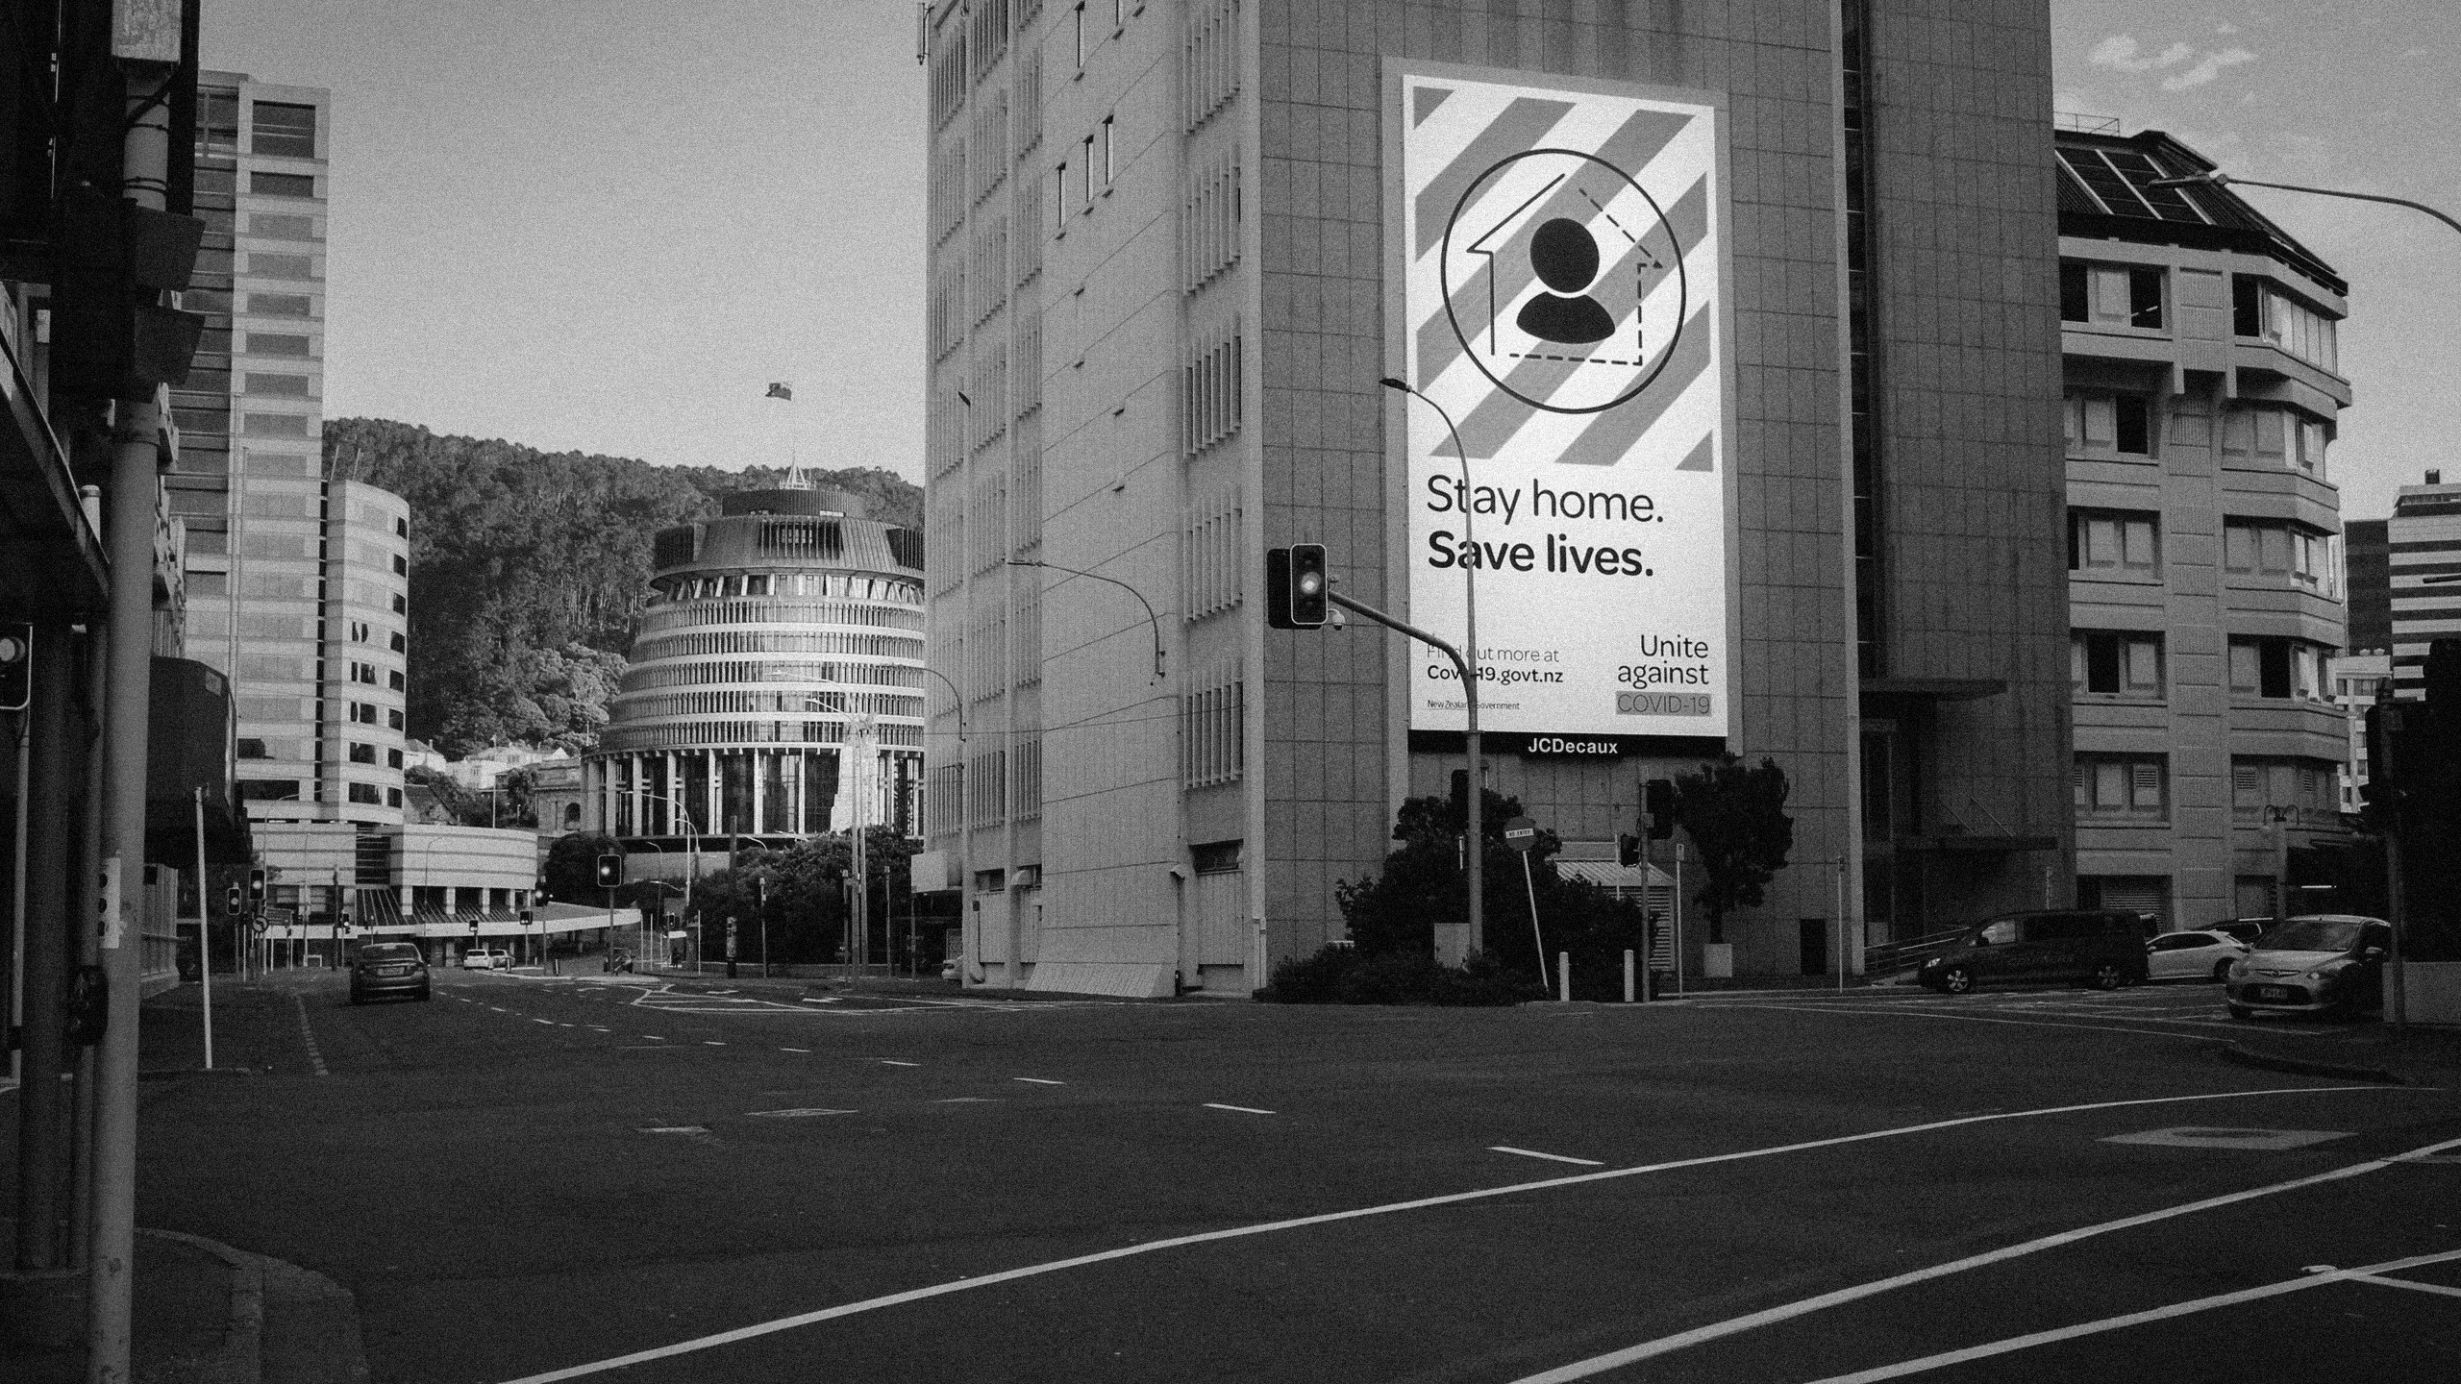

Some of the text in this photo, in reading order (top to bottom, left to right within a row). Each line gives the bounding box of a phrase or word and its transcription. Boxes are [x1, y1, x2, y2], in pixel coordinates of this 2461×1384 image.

[1427, 474, 1664, 526] Stay home.
[1428, 530, 1654, 577] Save lives.
[1497, 648, 1540, 662] more
[1543, 650, 1560, 662] at
[1640, 634, 1709, 658] Unite
[1427, 664, 1563, 686] Cov19.govt.nz
[1617, 660, 1709, 690] against
[1617, 693, 1710, 715] COVID-19
[1528, 737, 1618, 754] JCDecaux
